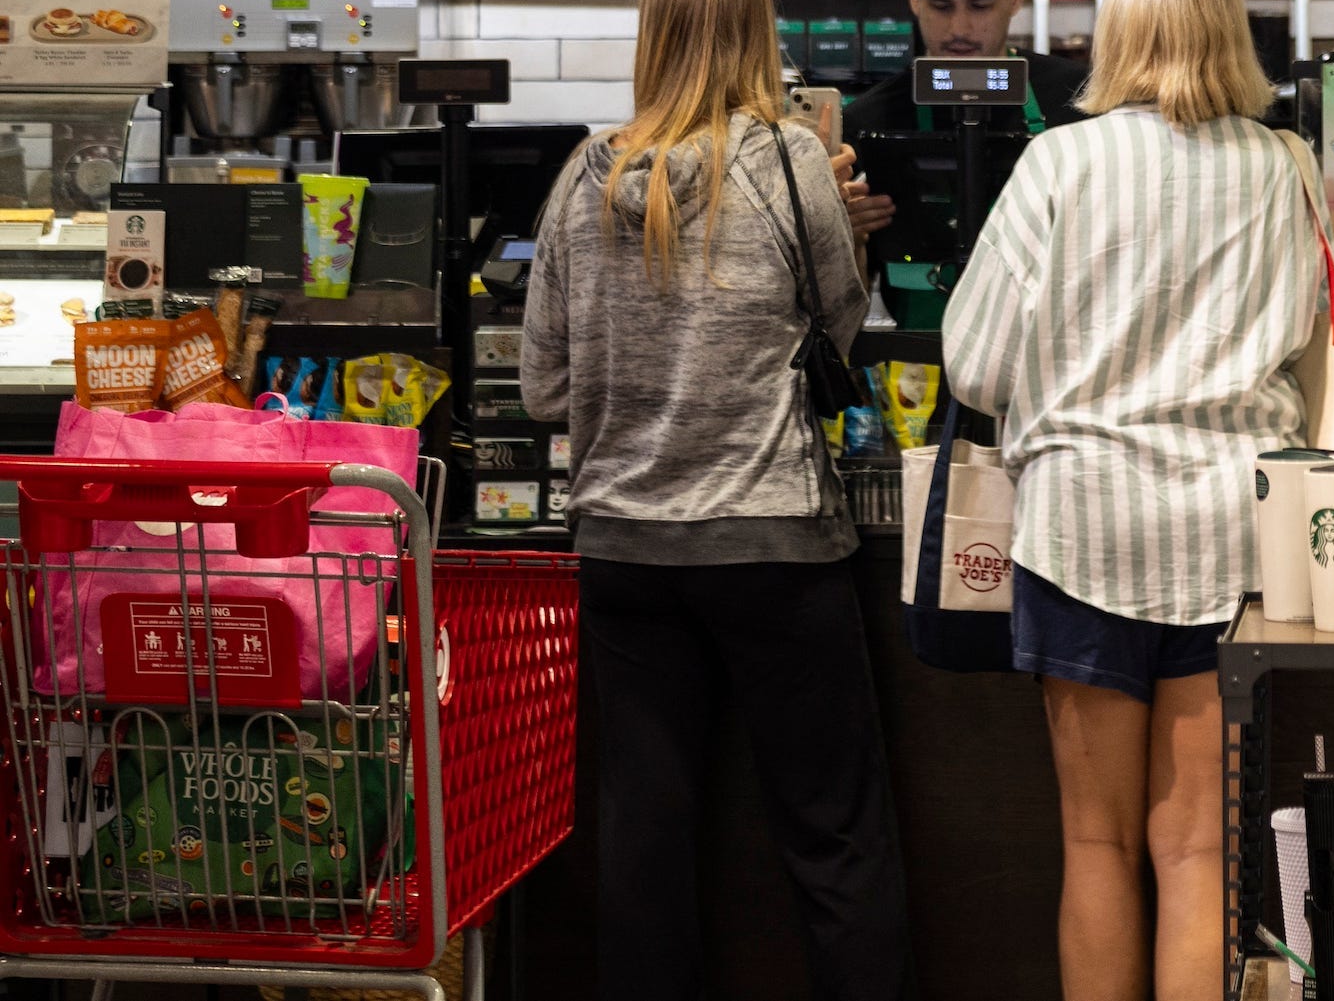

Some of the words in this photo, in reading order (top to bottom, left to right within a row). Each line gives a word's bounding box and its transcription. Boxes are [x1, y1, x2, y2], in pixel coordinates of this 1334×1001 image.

[86, 344, 156, 369] MOON
[167, 332, 216, 372] OON
[87, 367, 157, 389] CHEESE
[954, 553, 1012, 571] TRADER
[959, 568, 1004, 583] JOE'S
[182, 776, 274, 806] FOODS
[192, 805, 259, 819] MAKET
